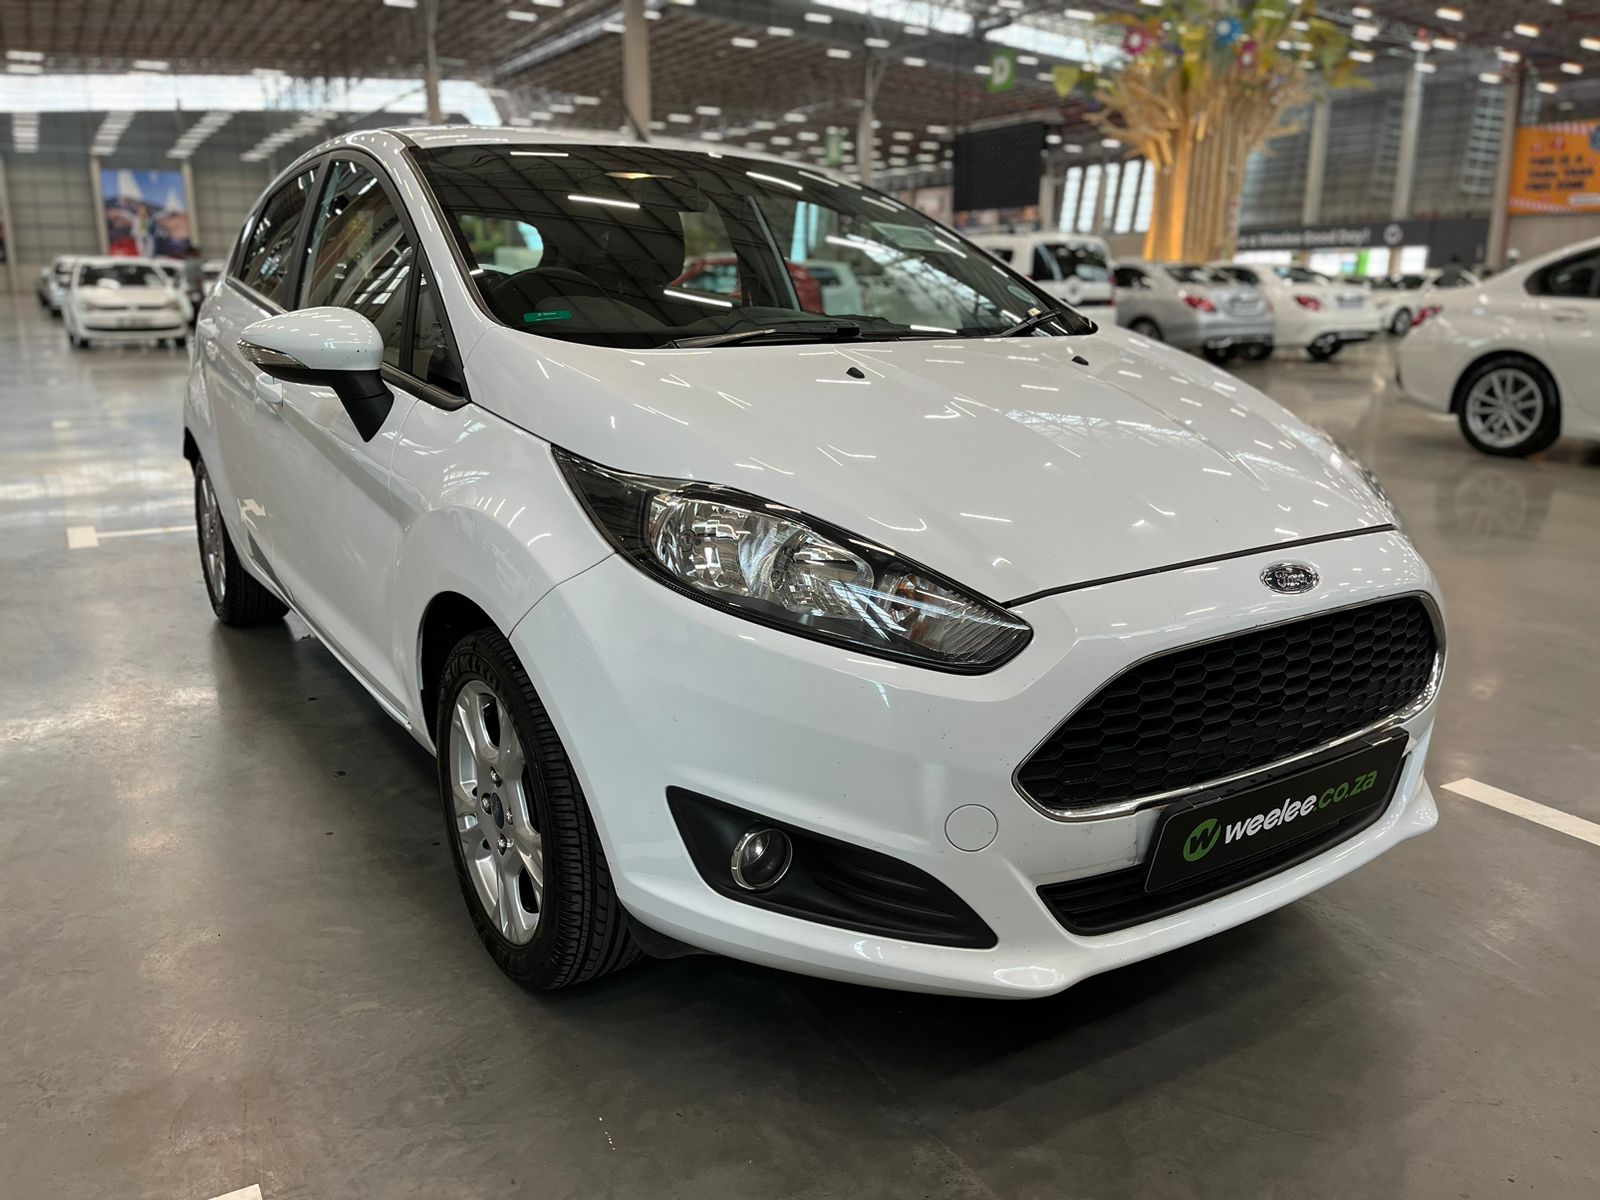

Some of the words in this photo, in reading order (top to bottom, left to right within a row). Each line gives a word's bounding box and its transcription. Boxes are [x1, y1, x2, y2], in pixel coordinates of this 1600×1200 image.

[1304, 229, 1335, 243] Good
[1340, 227, 1371, 246] Day!
[1225, 770, 1378, 844] weelee.co.za
